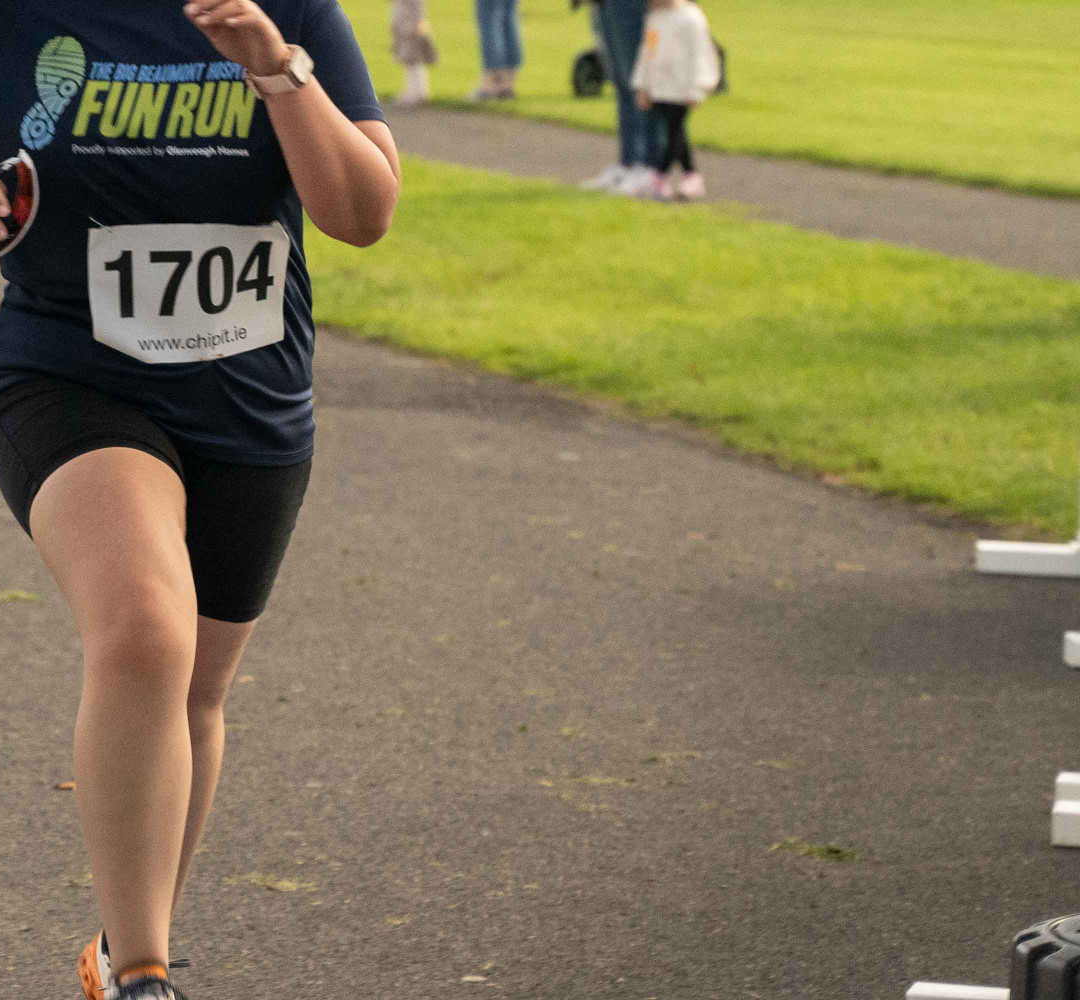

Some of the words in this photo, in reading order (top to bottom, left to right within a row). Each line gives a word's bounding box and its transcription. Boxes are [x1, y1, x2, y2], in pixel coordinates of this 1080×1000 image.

[89, 61, 115, 81] THE
[113, 62, 139, 82] BIG
[136, 62, 207, 83] BEAUMONT
[71, 79, 170, 139] FUN
[164, 81, 257, 139] RUN
[104, 240, 275, 319] 1704
[137, 326, 248, 351] www.chipit.ie
